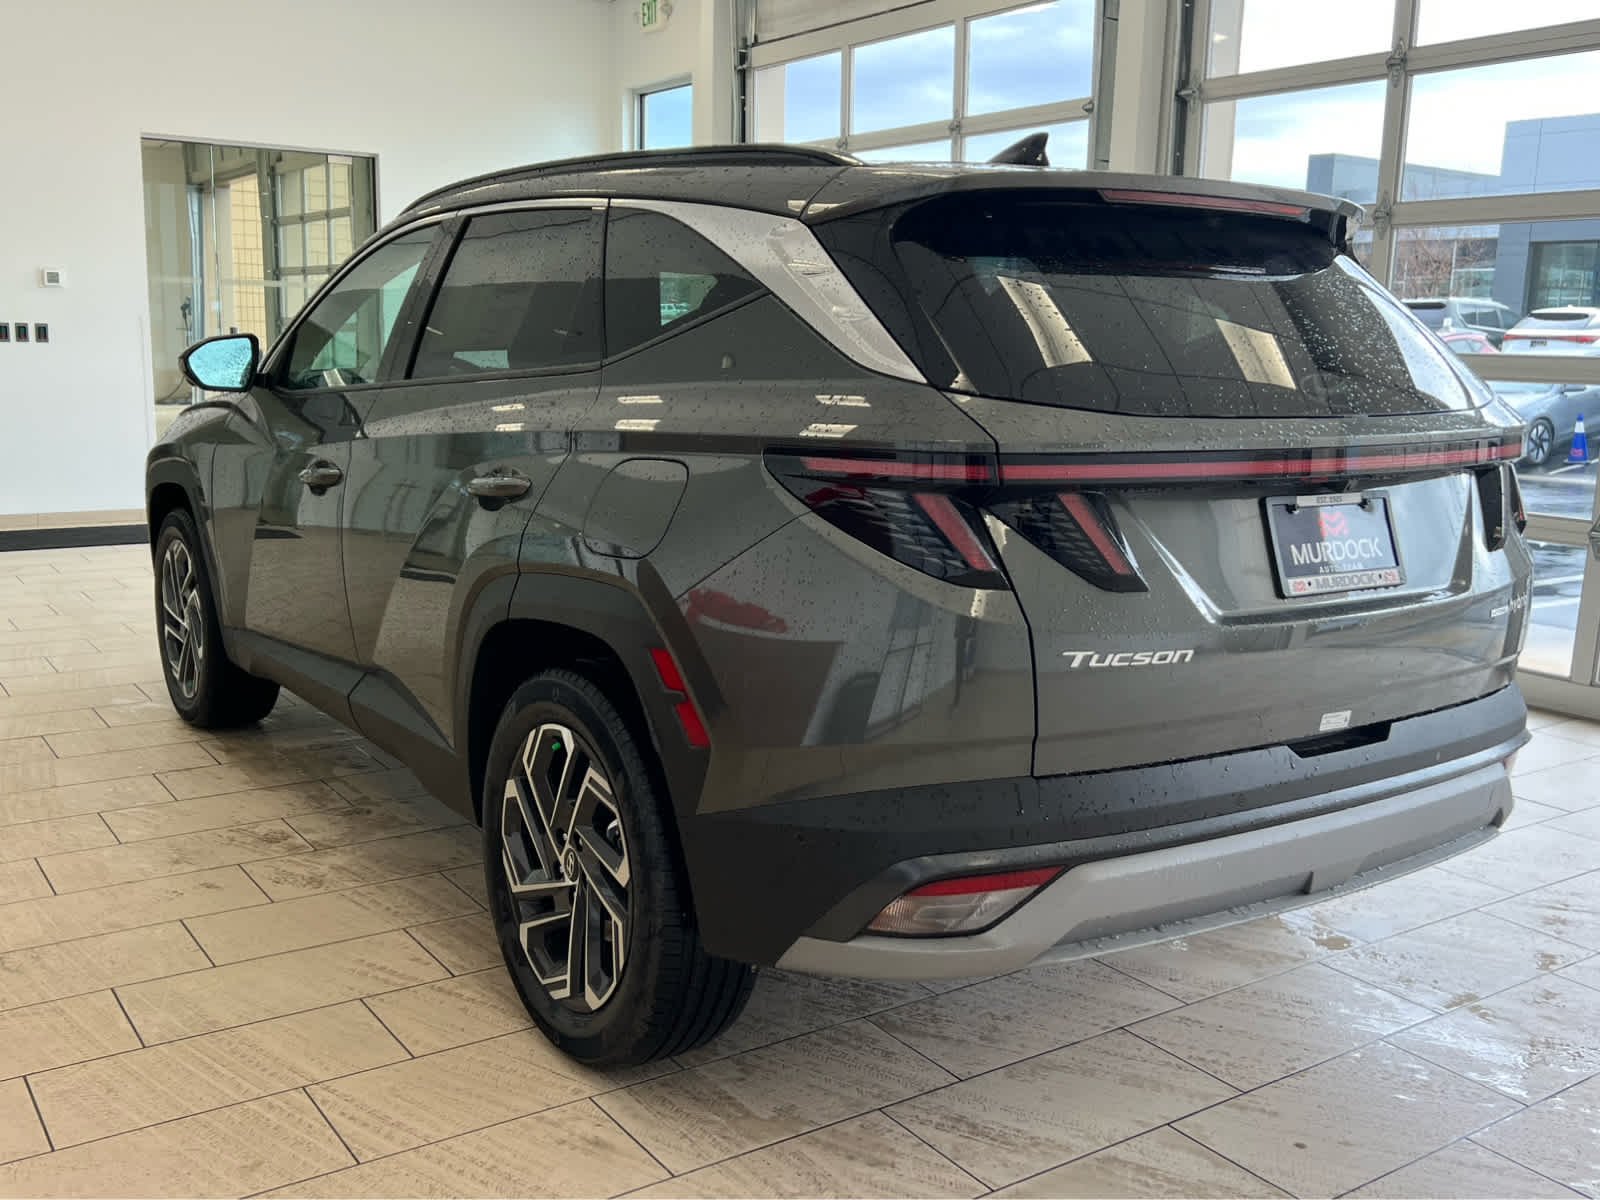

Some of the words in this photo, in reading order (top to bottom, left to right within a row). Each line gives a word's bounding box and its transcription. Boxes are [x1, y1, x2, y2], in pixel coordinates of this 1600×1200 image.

[642, 0, 657, 27] EXIT
[1290, 537, 1383, 566] MURDOCK
[1315, 573, 1376, 590] MURDOCK
